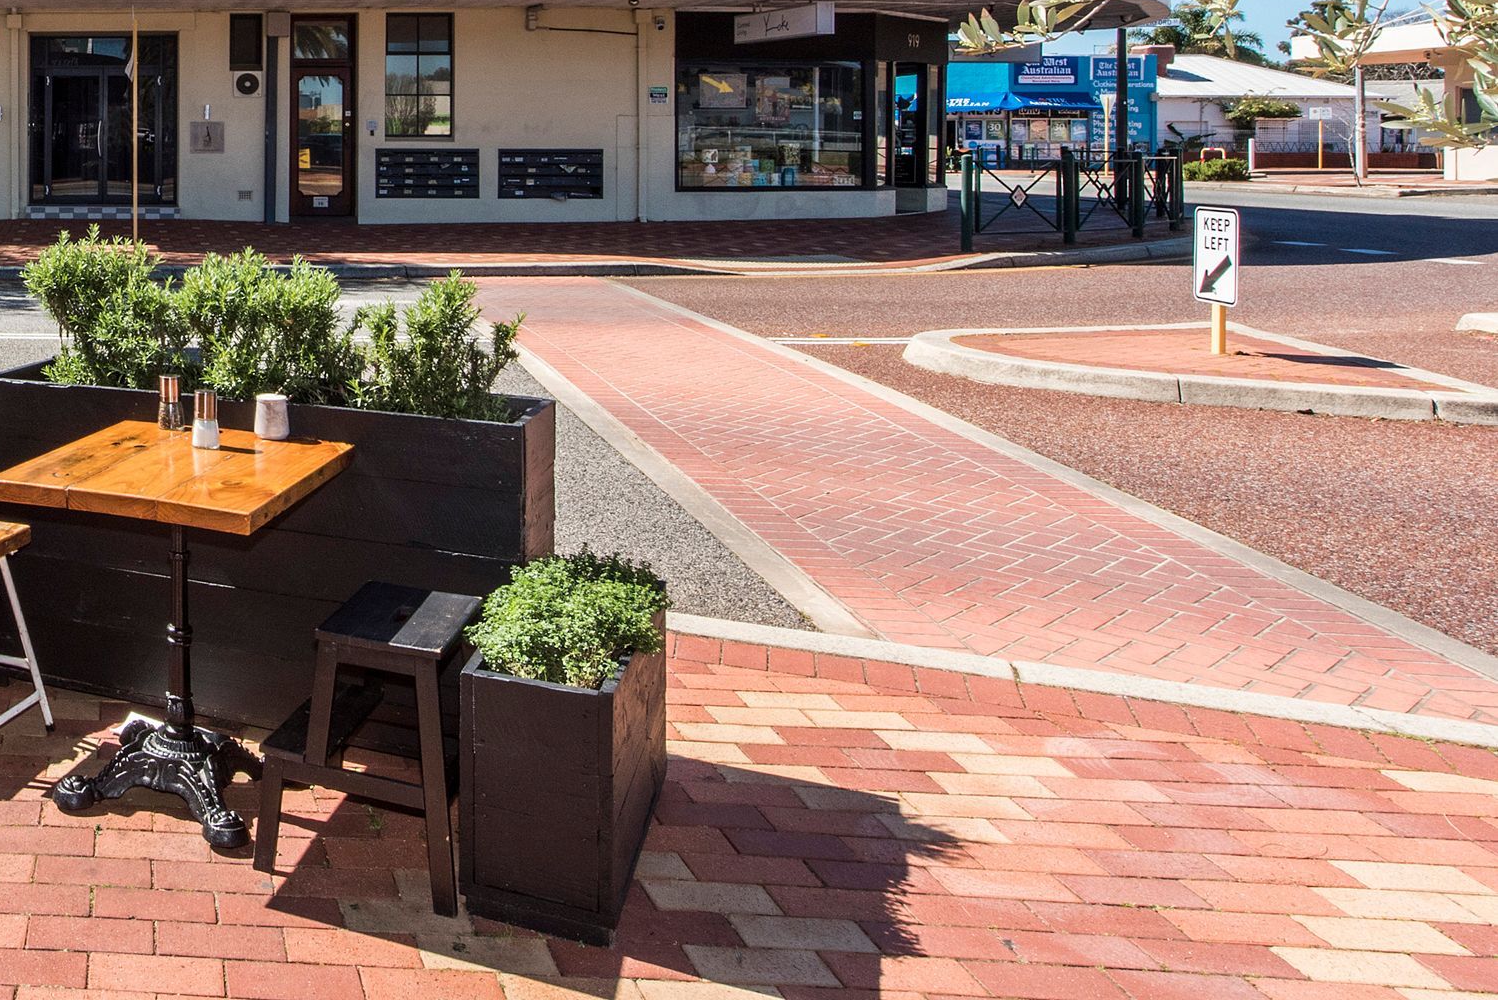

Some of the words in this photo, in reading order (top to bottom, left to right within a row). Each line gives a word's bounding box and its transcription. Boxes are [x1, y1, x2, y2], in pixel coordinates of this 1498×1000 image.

[908, 34, 920, 48] 919
[1042, 57, 1068, 66] West
[1021, 65, 1072, 75] Australian
[1203, 216, 1231, 232] KEEP
[1204, 236, 1229, 252] LEFT
